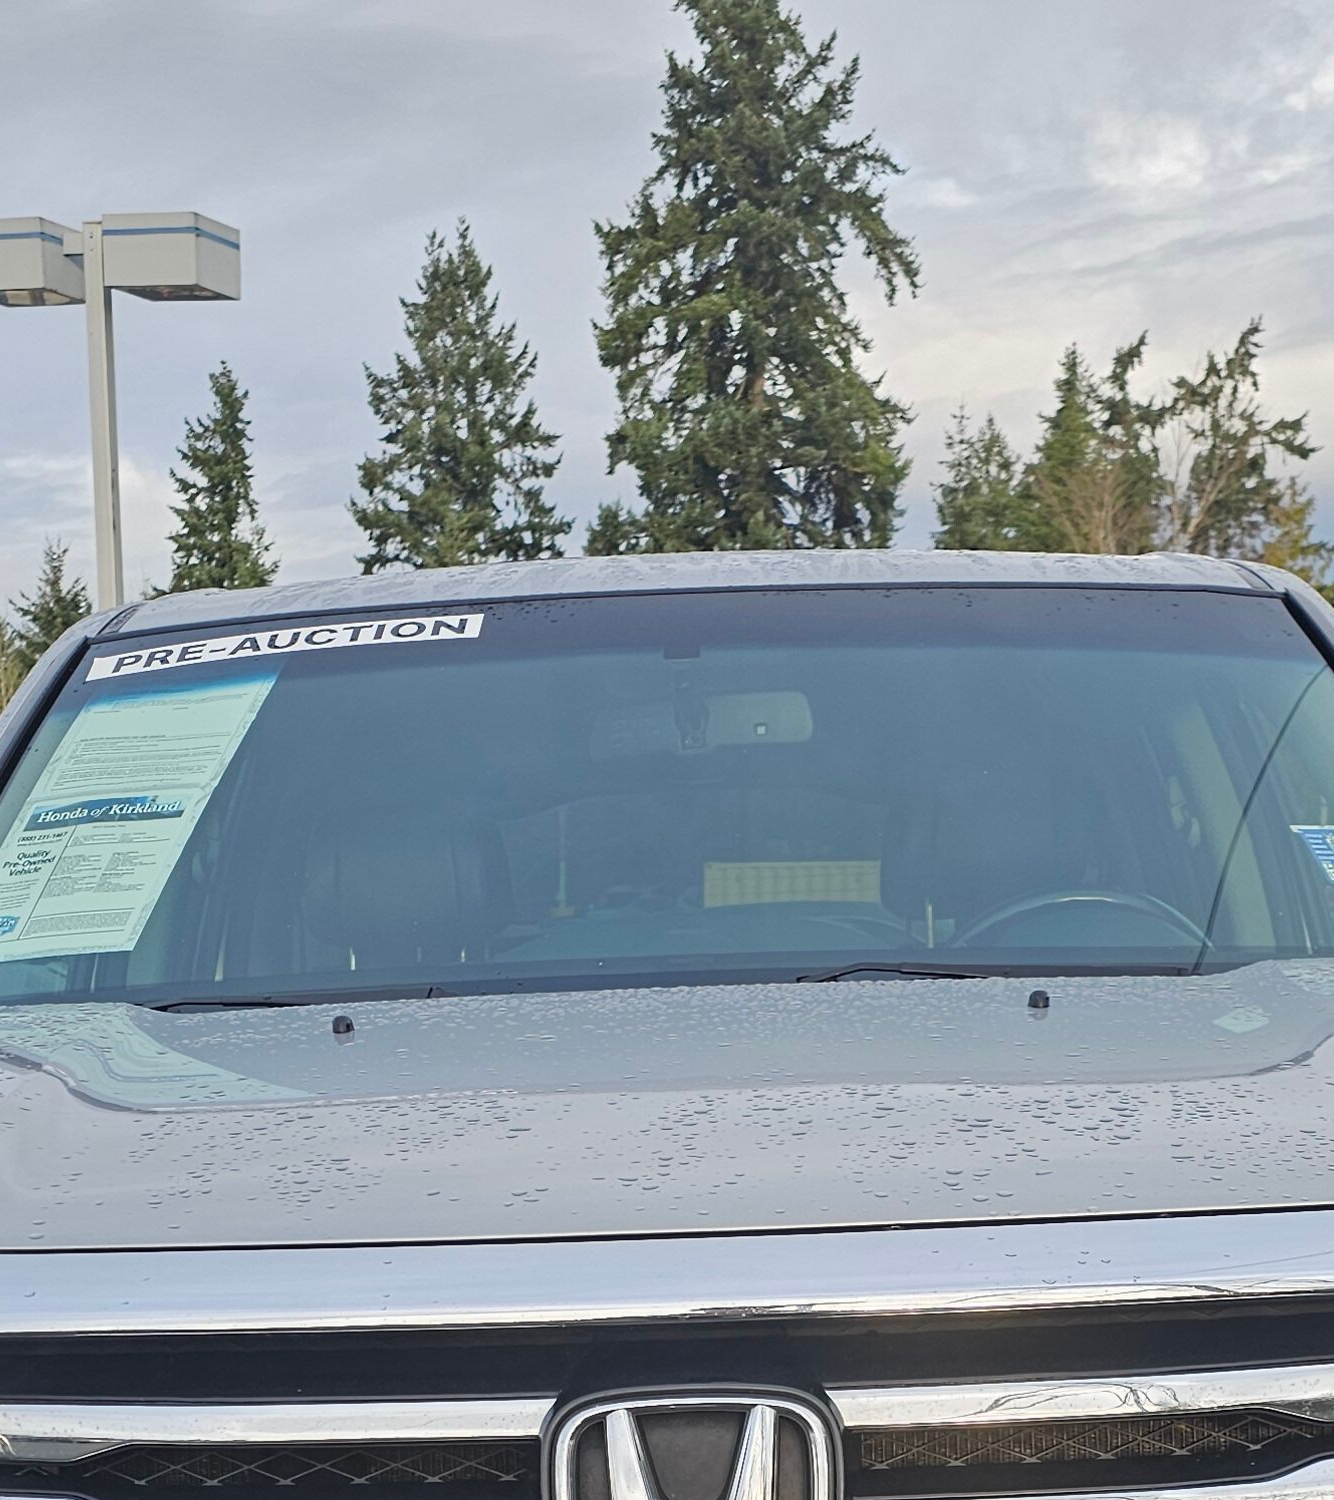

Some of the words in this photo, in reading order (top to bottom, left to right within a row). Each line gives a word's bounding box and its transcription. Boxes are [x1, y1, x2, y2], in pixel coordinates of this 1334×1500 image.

[111, 618, 469, 674] PRE-AUCTION
[36, 808, 88, 823] Honda
[90, 806, 109, 818] of
[108, 800, 181, 816] Kirkland
[2, 855, 57, 869] Pre-Owned
[17, 850, 52, 861] Quality
[9, 866, 42, 877] Vehicle
